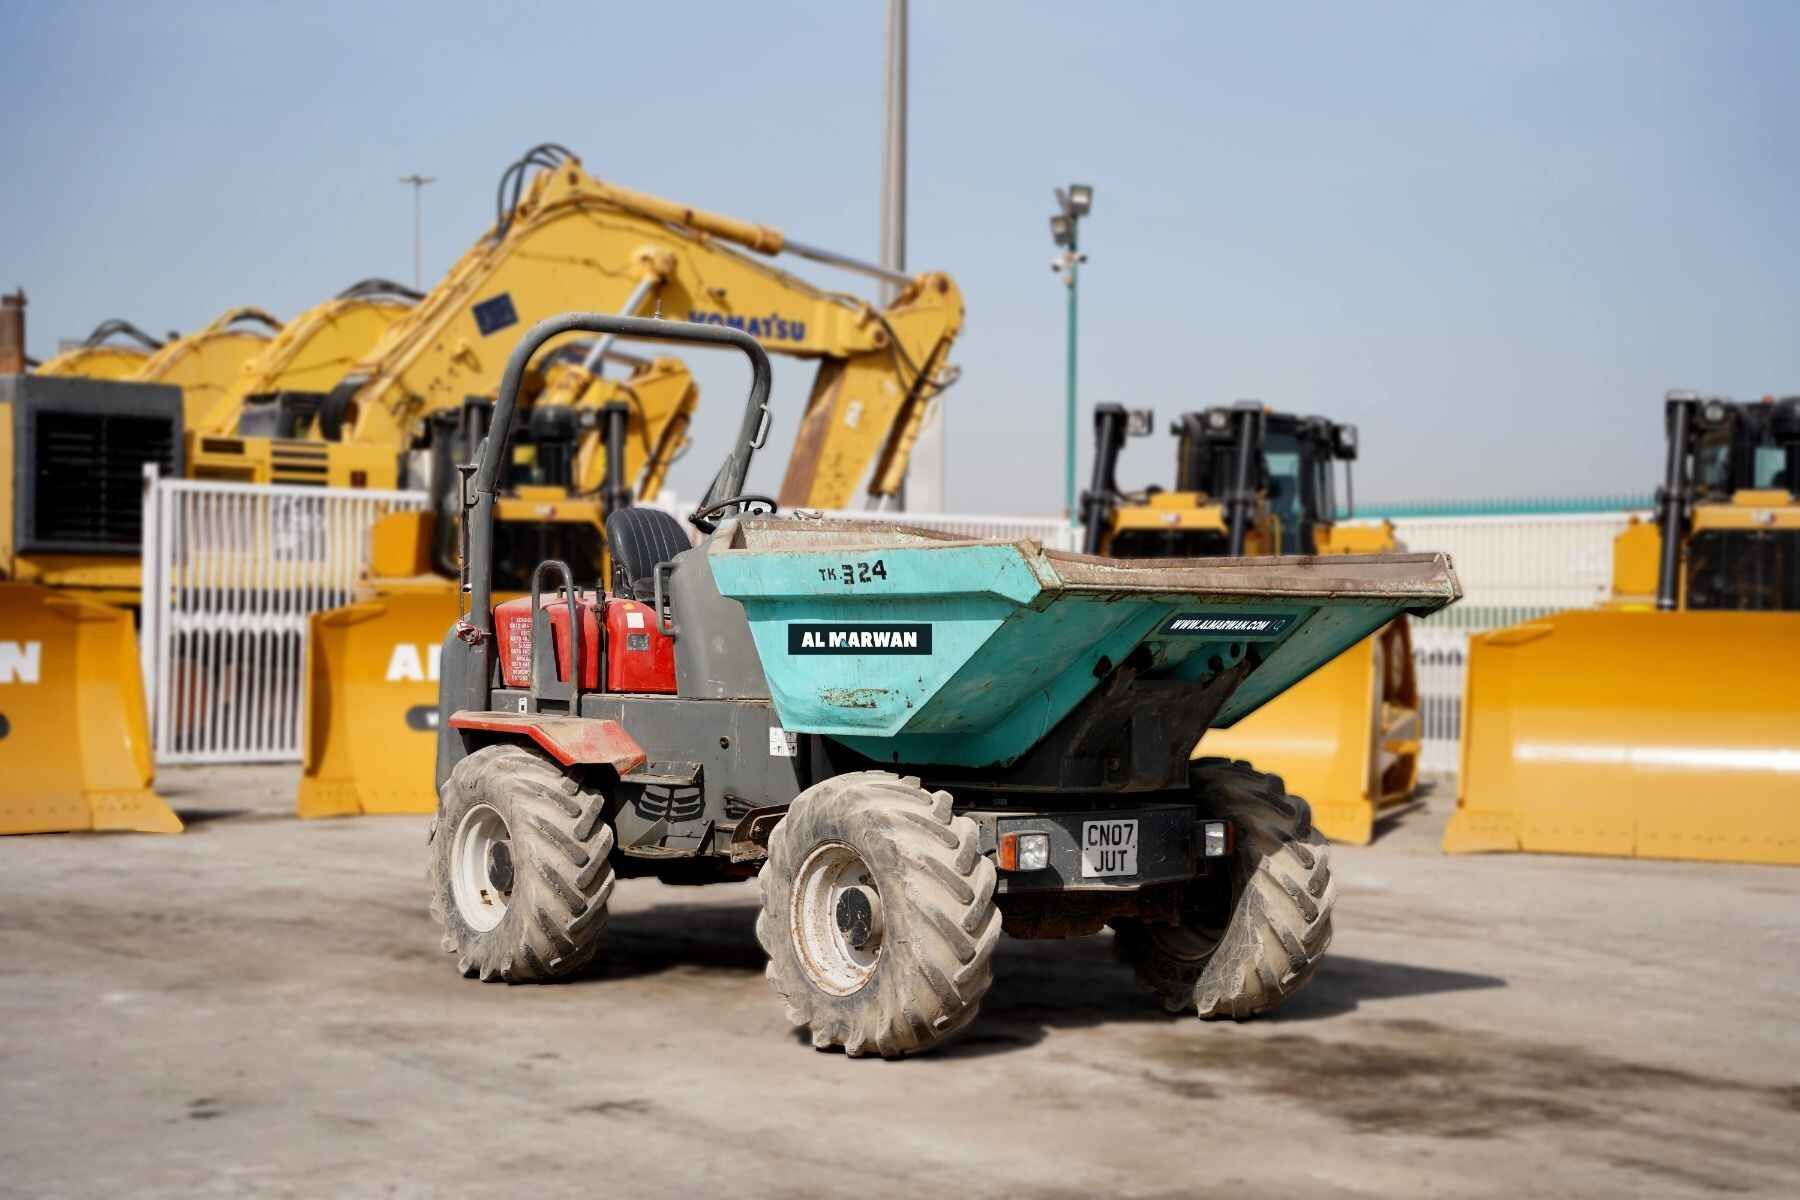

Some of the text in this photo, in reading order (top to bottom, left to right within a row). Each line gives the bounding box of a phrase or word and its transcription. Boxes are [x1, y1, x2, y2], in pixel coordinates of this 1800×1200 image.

[1169, 619, 1270, 631] WWW.ALMARWAN.COM
[802, 632, 917, 647] AL MARWAN
[1094, 850, 1127, 872] JUT
